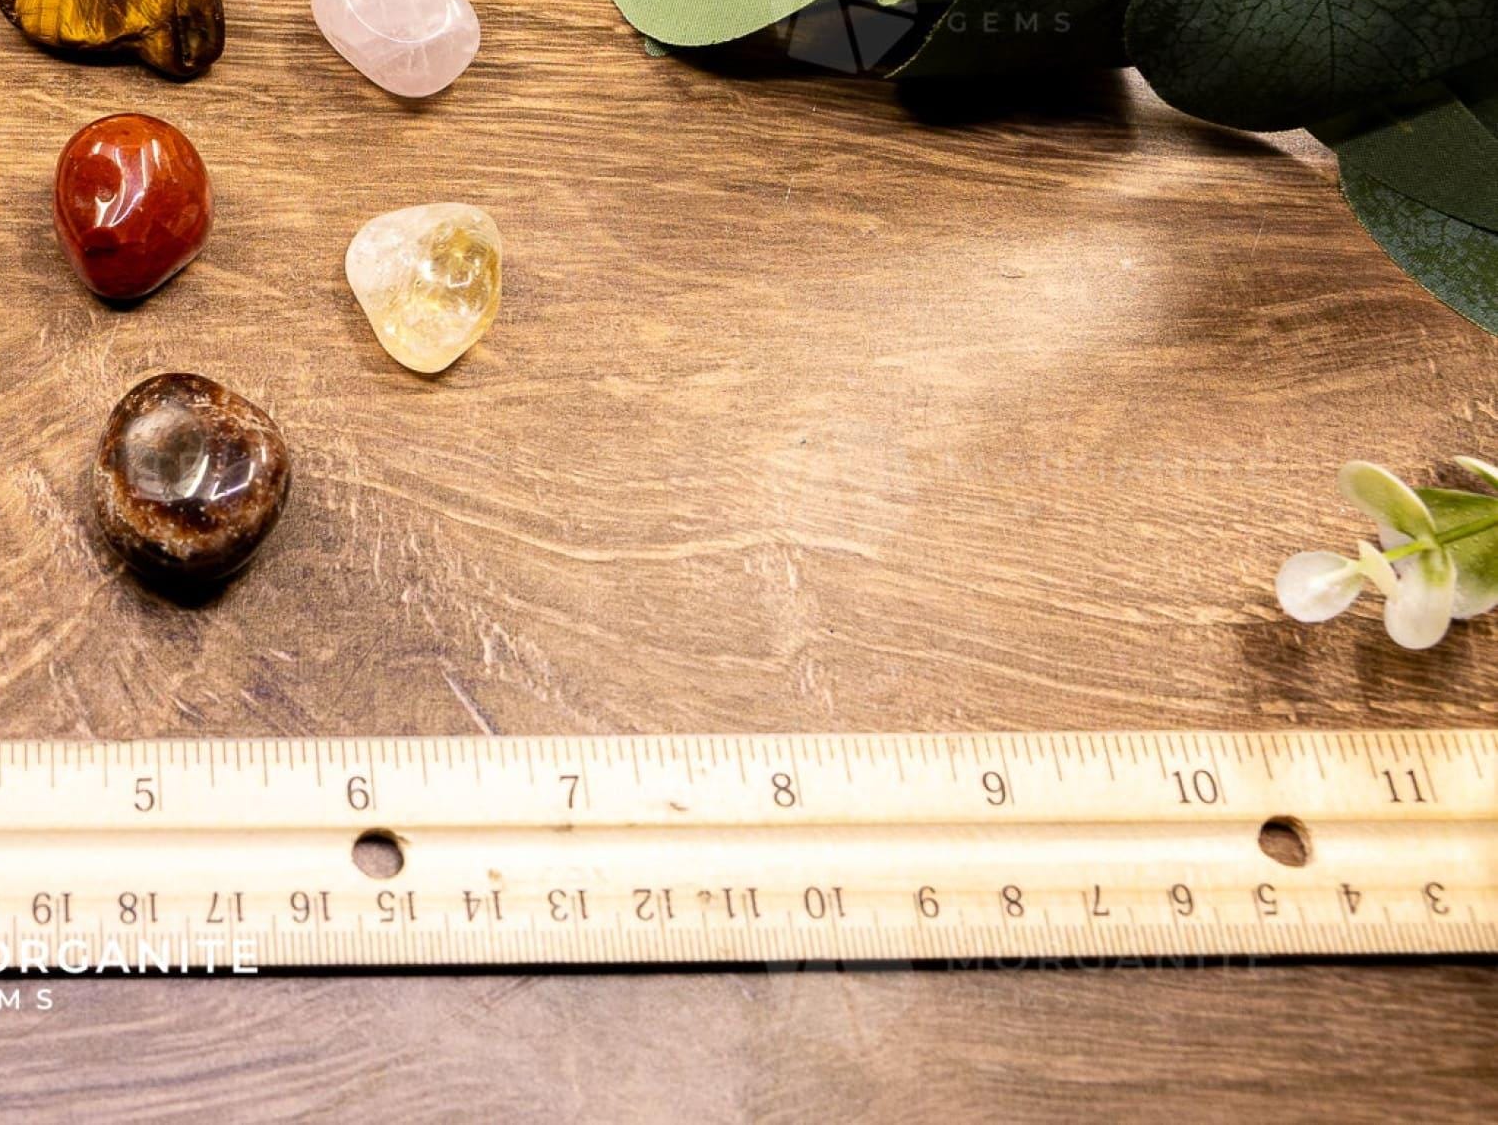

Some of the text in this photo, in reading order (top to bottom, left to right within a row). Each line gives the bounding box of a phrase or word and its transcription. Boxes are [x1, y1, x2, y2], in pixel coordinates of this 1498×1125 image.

[134, 777, 155, 811] 5
[346, 776, 370, 810] 6
[559, 775, 579, 809] 7
[771, 773, 796, 807] 8
[982, 771, 1006, 805] 9
[1172, 770, 1218, 804] 10
[1381, 770, 1426, 803] 11
[32, 892, 73, 924] 19
[118, 892, 159, 924] 18
[206, 891, 245, 923] 17
[290, 891, 332, 923] 16
[377, 890, 418, 922] 15
[463, 890, 503, 921] 14
[547, 889, 590, 921] 13
[633, 888, 677, 921] 12
[721, 888, 762, 919] 11
[804, 887, 846, 919] 10
[918, 886, 940, 918] 9
[1001, 885, 1025, 918] 8
[1092, 885, 1110, 916] 7
[1171, 884, 1194, 916] 6
[1257, 884, 1277, 915] 5
[1341, 883, 1360, 914] 4
[1424, 882, 1449, 915] 3
